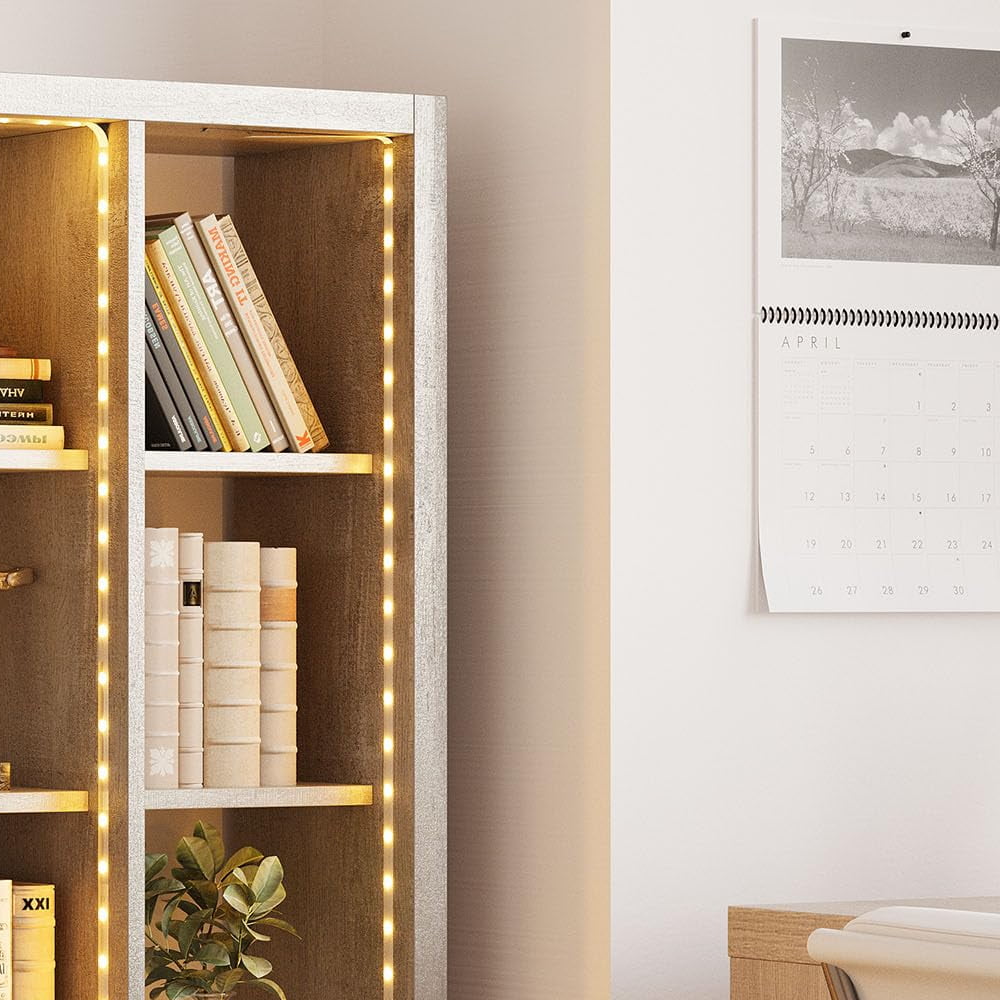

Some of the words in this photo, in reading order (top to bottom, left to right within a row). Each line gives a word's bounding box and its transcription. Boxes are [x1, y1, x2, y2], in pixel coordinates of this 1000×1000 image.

[781, 335, 842, 350] APRIL
[951, 402, 958, 412] 2
[986, 403, 992, 413] 3
[809, 445, 815, 455] 5
[844, 446, 851, 456] 6
[880, 447, 886, 456] 7
[916, 447, 922, 457] 8
[951, 448, 957, 457] 9
[981, 448, 992, 457] 10
[804, 492, 816, 502] 12
[840, 492, 851, 502] 13
[875, 493, 886, 502] 14
[911, 493, 922, 503] 15
[946, 493, 957, 503] 16
[981, 494, 992, 503] 17
[806, 540, 817, 549] 19
[840, 540, 853, 550] 20
[875, 540, 887, 550] 21
[911, 539, 924, 550] 22
[946, 540, 959, 550] 23
[981, 541, 993, 550] 24
[810, 586, 823, 596] 26
[846, 586, 858, 596] 27
[881, 586, 894, 596] 28
[917, 586, 929, 595] 29
[953, 586, 965, 596] 30
[22, 897, 50, 911] XXI
